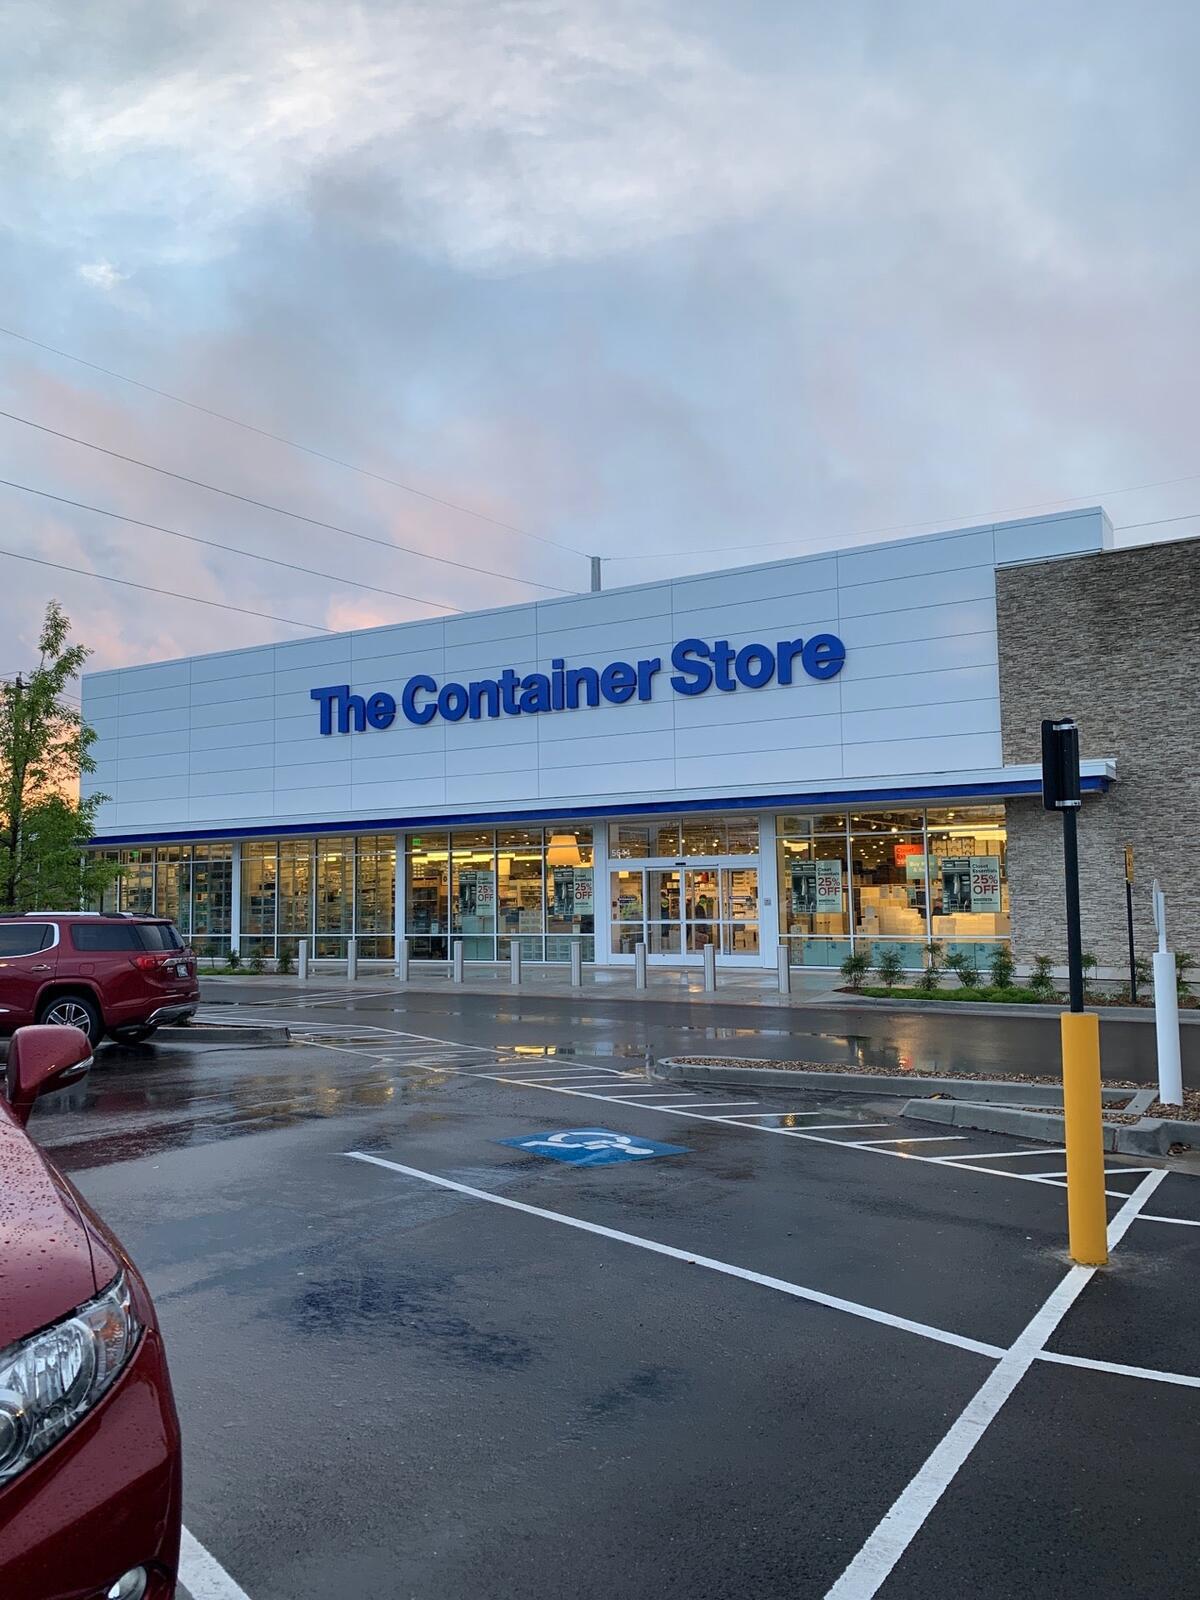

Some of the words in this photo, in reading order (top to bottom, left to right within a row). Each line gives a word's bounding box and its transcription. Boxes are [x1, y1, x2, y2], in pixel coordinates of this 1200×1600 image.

[310, 684, 397, 736] The
[402, 657, 661, 726] Container
[670, 633, 846, 697] Store
[817, 877, 840, 887] 25%
[972, 874, 998, 884] 25%
[575, 882, 592, 891] 25%
[973, 885, 998, 895] OFF
[575, 891, 593, 900] OFF
[818, 887, 840, 896] OFF
[477, 893, 494, 902] OFF
